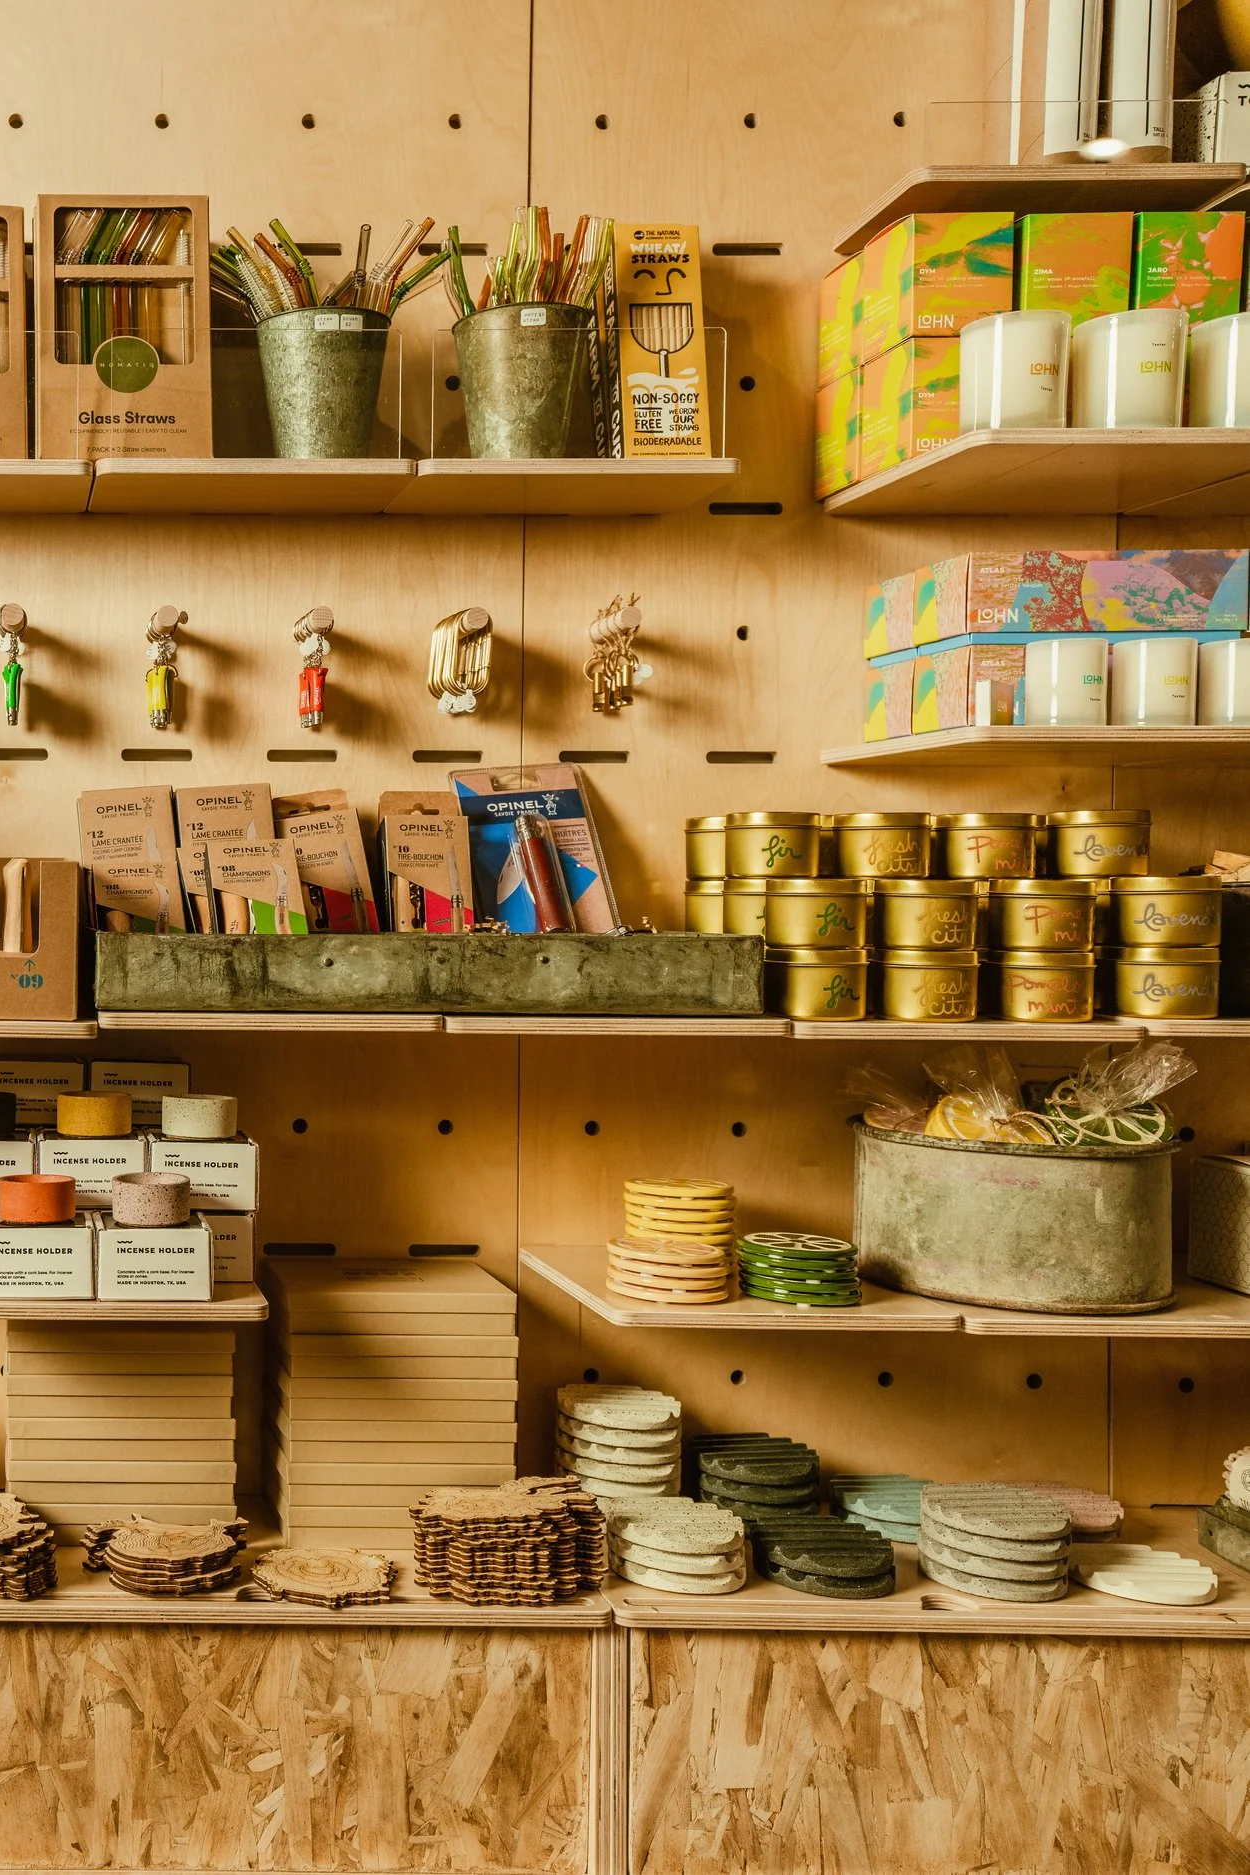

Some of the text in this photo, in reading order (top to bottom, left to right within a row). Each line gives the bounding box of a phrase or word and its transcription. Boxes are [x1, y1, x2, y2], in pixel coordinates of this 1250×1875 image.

[631, 254, 689, 263] STRAWS
[918, 315, 954, 329] LOHN
[1030, 363, 1059, 376] LOHN
[1140, 361, 1172, 374] LOHN
[633, 392, 699, 404] NON-SOGGY
[79, 411, 176, 425] Glass Straws
[673, 415, 694, 424] OUR
[635, 419, 662, 430] FREE
[611, 409, 622, 458] CUP
[978, 608, 1018, 623] LOHN
[1164, 675, 1189, 685] LOHN
[196, 796, 242, 807] OPINEL
[487, 800, 544, 813] OPINEL
[96, 803, 142, 815] OPINEL
[517, 808, 540, 816] FRANCE
[191, 828, 244, 839] LAME CRANTÉE
[289, 821, 334, 834] OPINEL
[400, 824, 443, 832] OPINEL
[554, 829, 587, 838] HUÎTRES
[92, 834, 144, 847] LAME CRANTÉE
[223, 846, 269, 855] OPINEL
[762, 835, 802, 868] fir
[863, 831, 922, 866] fresh
[296, 850, 338, 863] RE-BOUCHON
[397, 853, 444, 861] TIRE-BOUCHON
[222, 870, 271, 878] CHAMPIGNONS
[816, 902, 856, 937] fir
[823, 974, 860, 1009] fir
[204, 1161, 239, 1169] HOLDER
